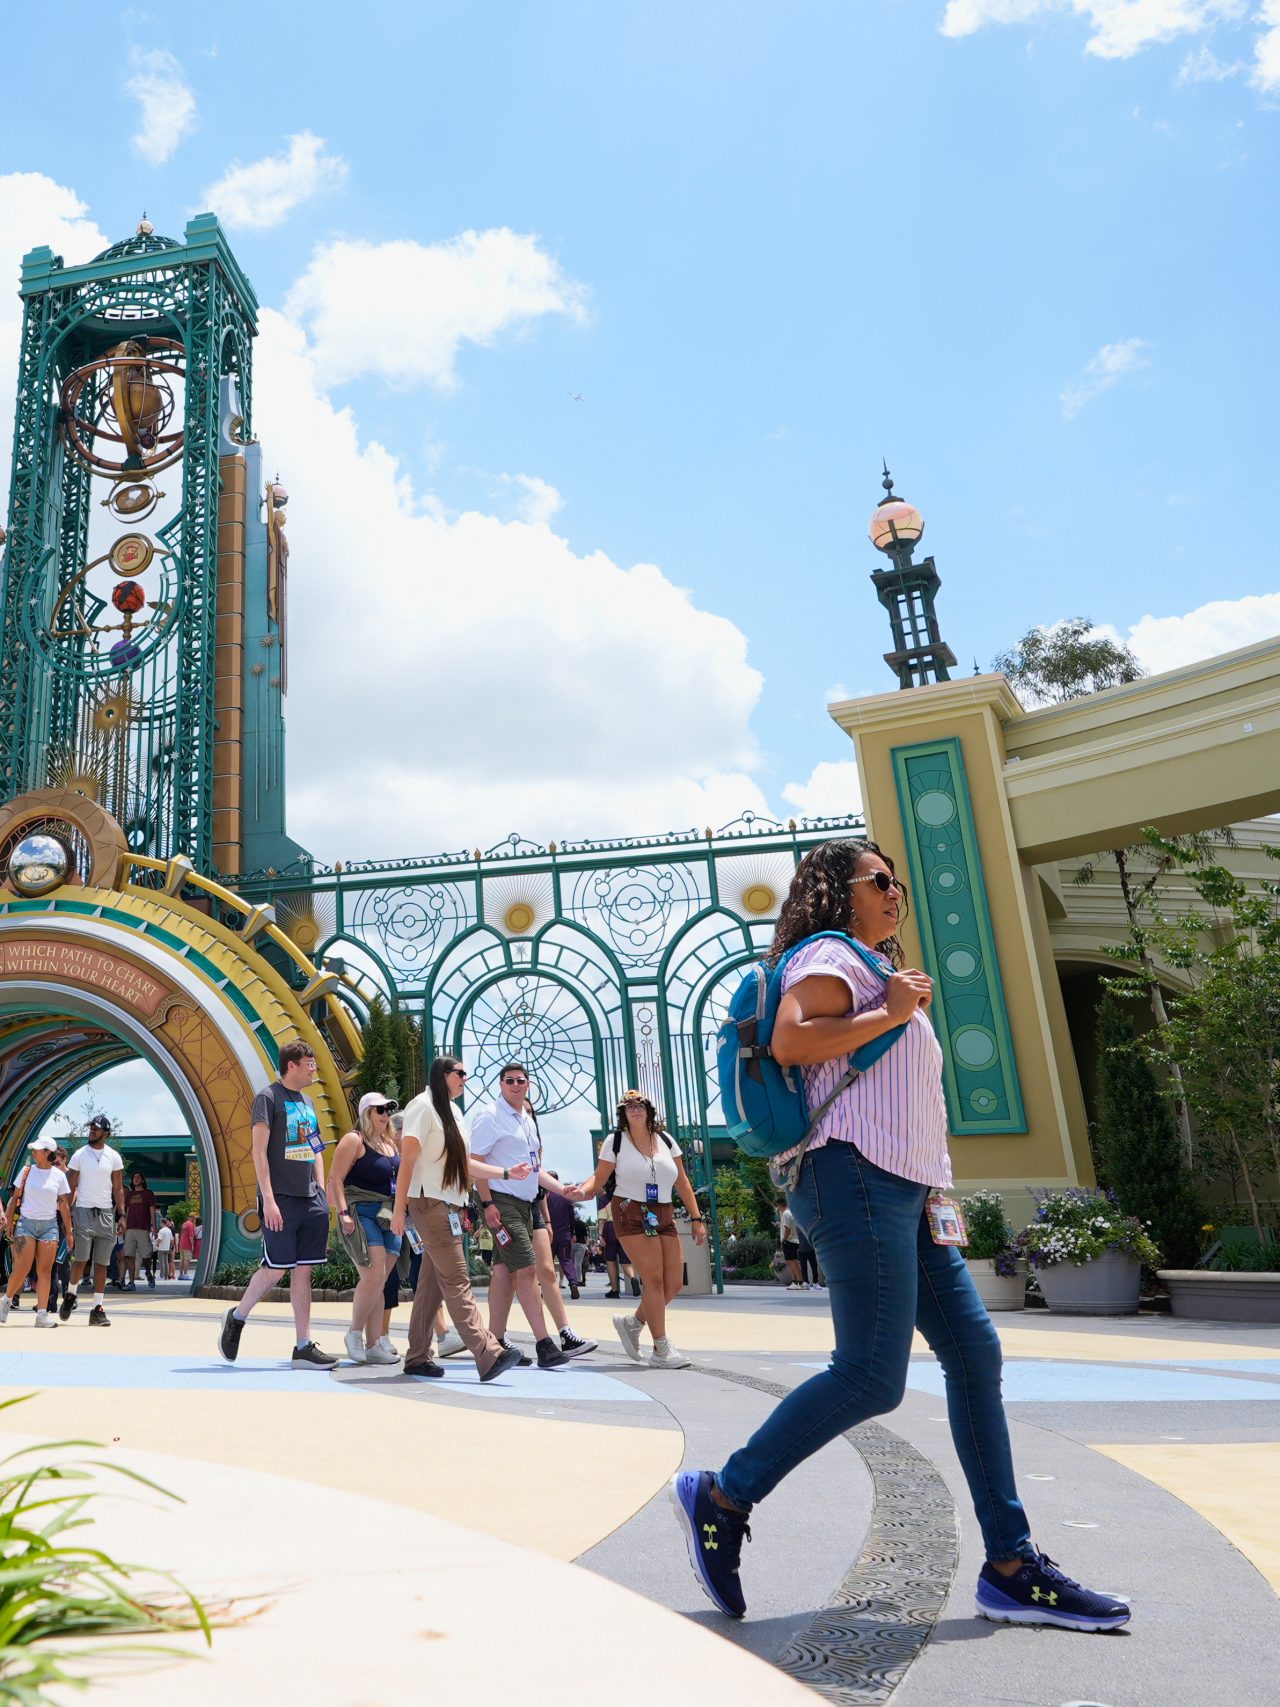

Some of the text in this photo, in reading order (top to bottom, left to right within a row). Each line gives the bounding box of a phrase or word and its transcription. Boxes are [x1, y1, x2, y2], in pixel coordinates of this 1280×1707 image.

[6, 959, 59, 972] WITHIN
[63, 962, 99, 982] YOUR
[101, 976, 143, 1004] HEART
[9, 946, 56, 957] WHICH
[60, 948, 93, 964] PATH
[97, 956, 114, 972] TO
[116, 966, 159, 997] CHART
